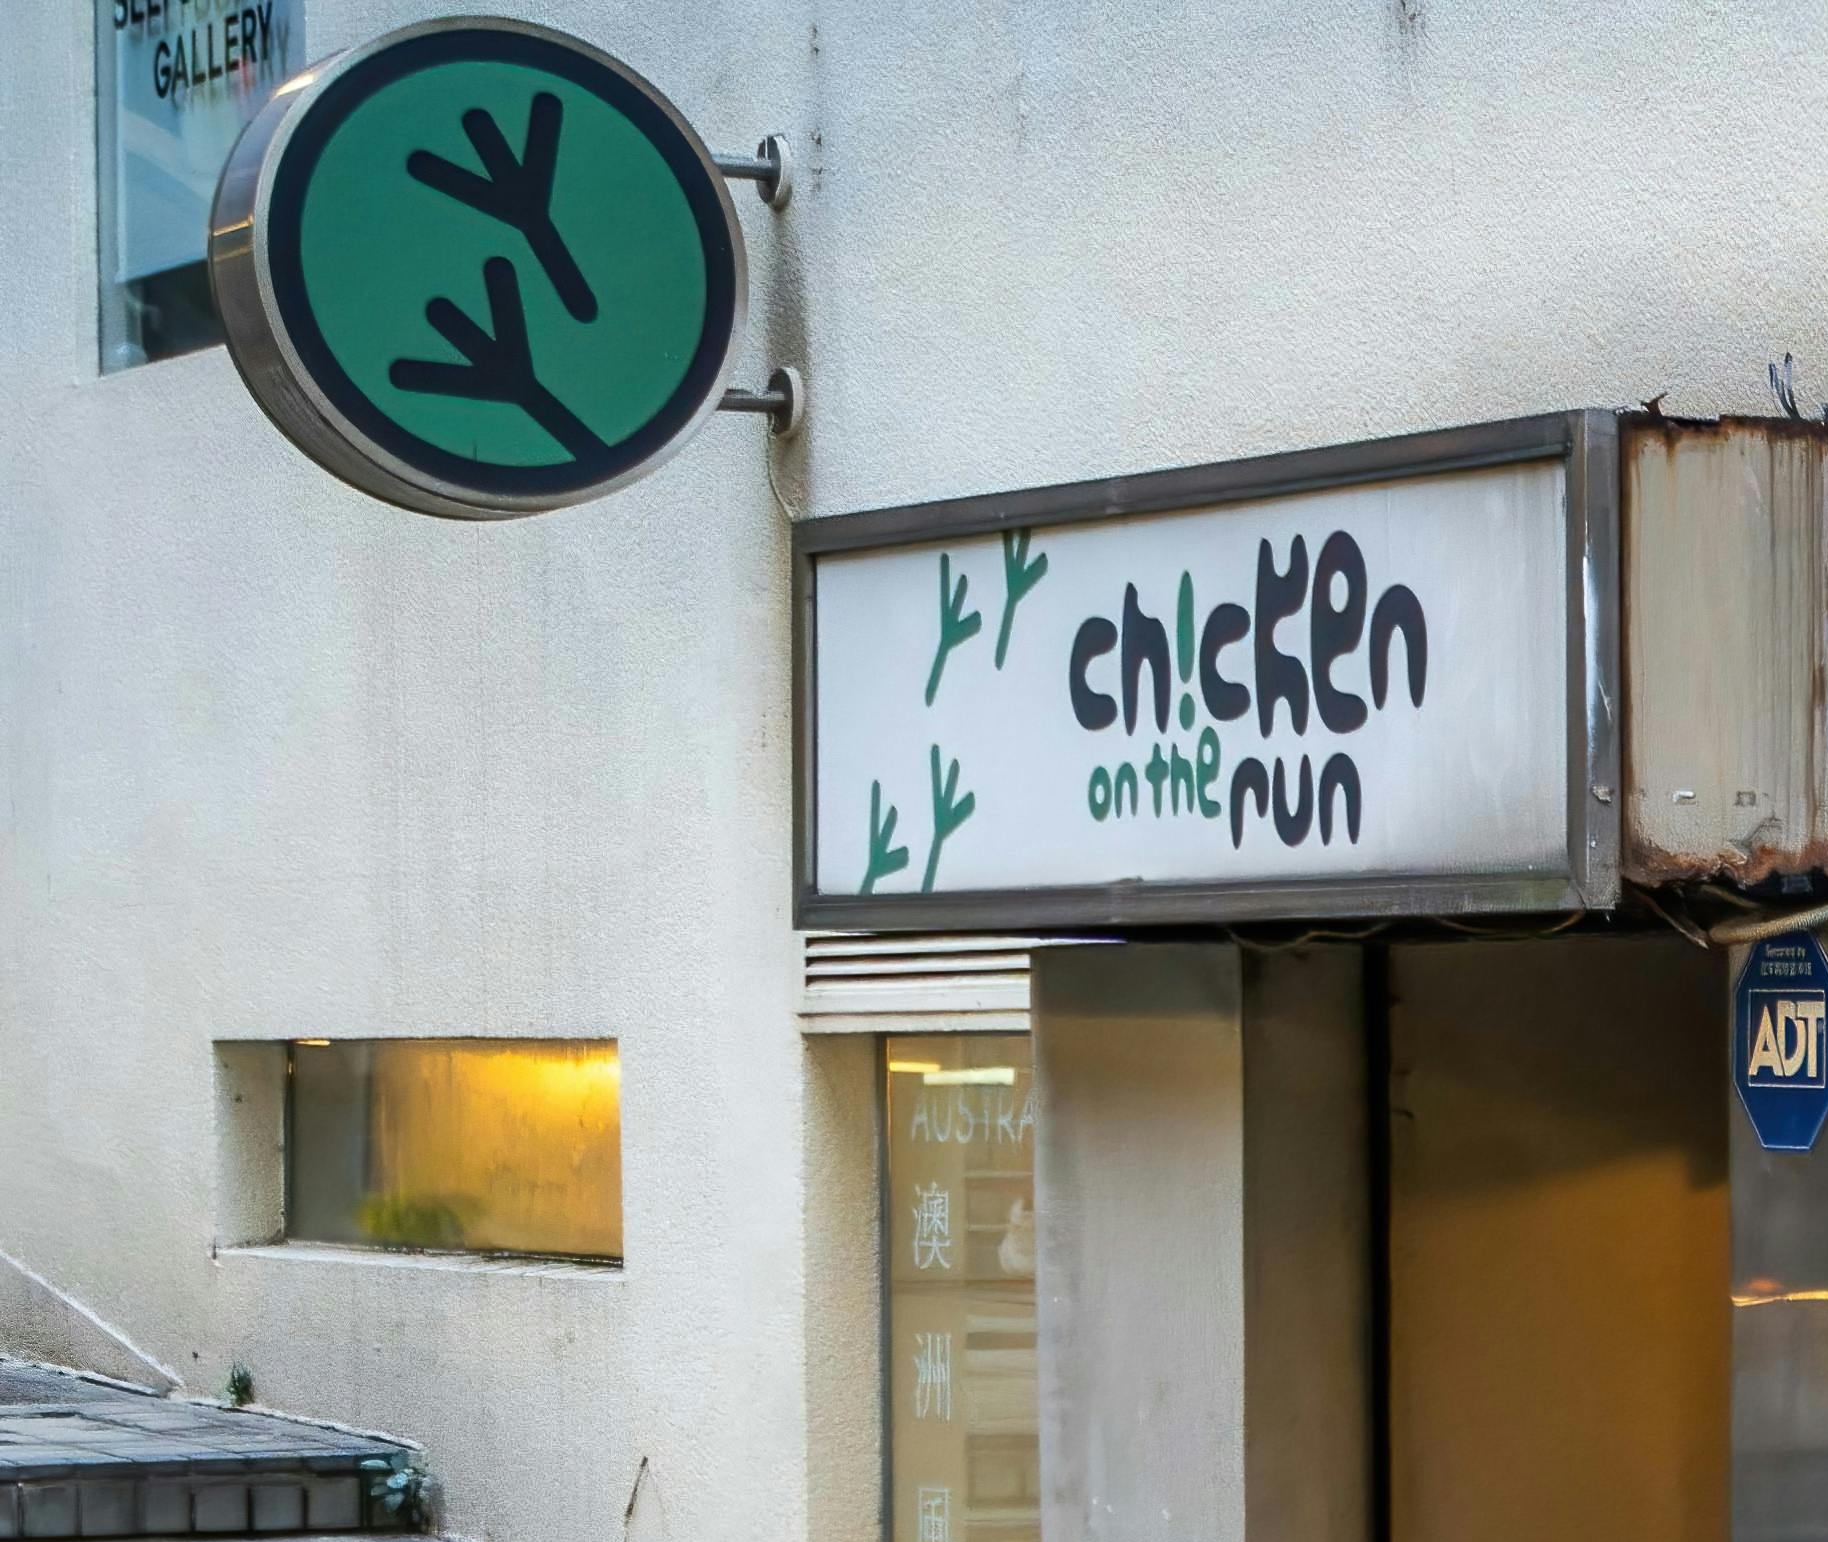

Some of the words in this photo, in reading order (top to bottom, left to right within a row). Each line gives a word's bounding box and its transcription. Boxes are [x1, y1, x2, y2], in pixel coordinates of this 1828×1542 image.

[154, 1, 273, 99] GALLERY
[1230, 752, 1361, 850] run
[1747, 1000, 1825, 1079] ADT
